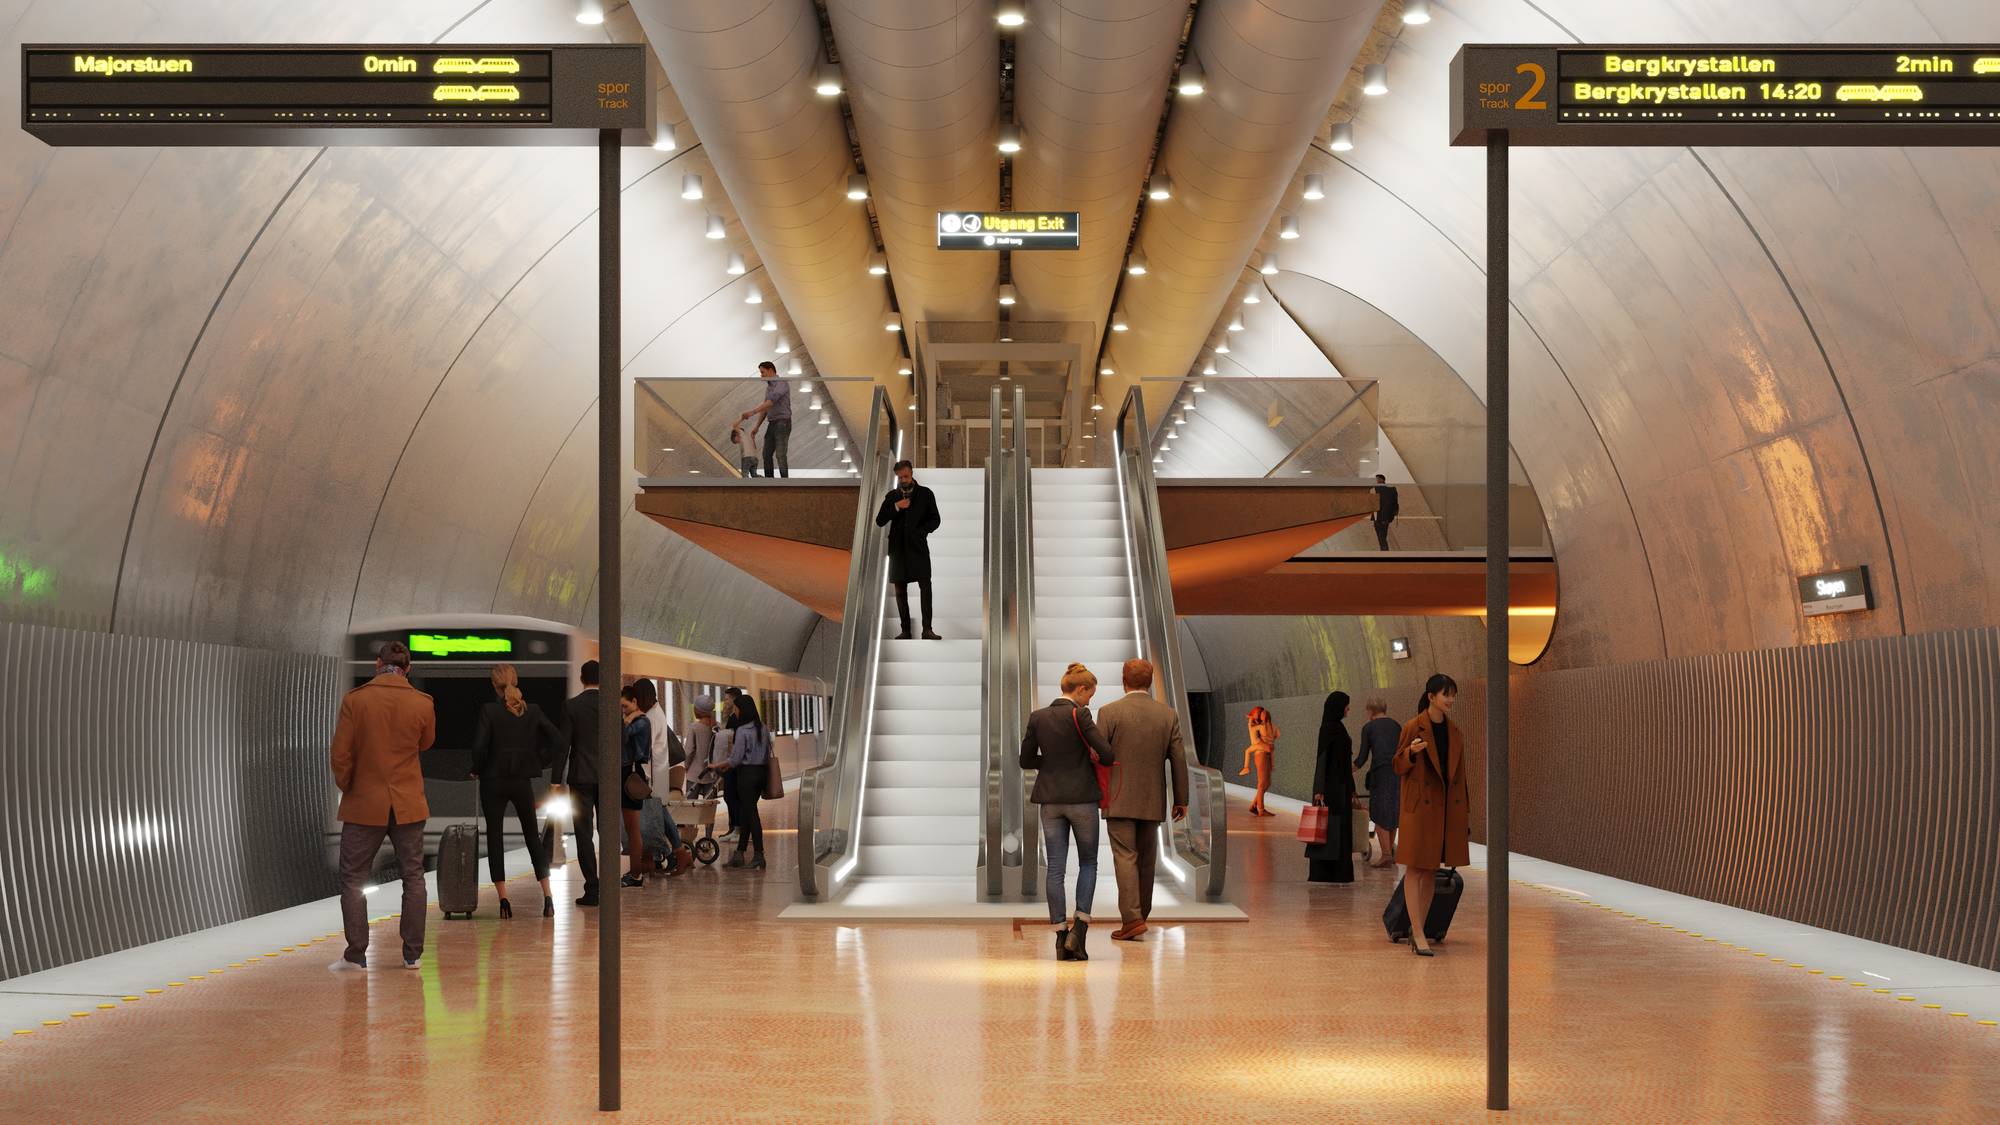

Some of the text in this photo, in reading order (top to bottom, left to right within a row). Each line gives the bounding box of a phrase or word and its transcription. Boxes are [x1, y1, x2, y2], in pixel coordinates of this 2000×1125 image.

[75, 56, 417, 75] Majorstuen 0min
[1604, 55, 1953, 77] Bergkrystallen 2min
[598, 83, 630, 96] spor
[1479, 83, 1511, 96] spor
[1514, 63, 1547, 110] 2
[1574, 83, 1822, 104] Bergkrystallen 14:20
[598, 98, 629, 109] Track
[1479, 98, 1509, 109] Track
[984, 216, 1065, 233] Utgang Exit
